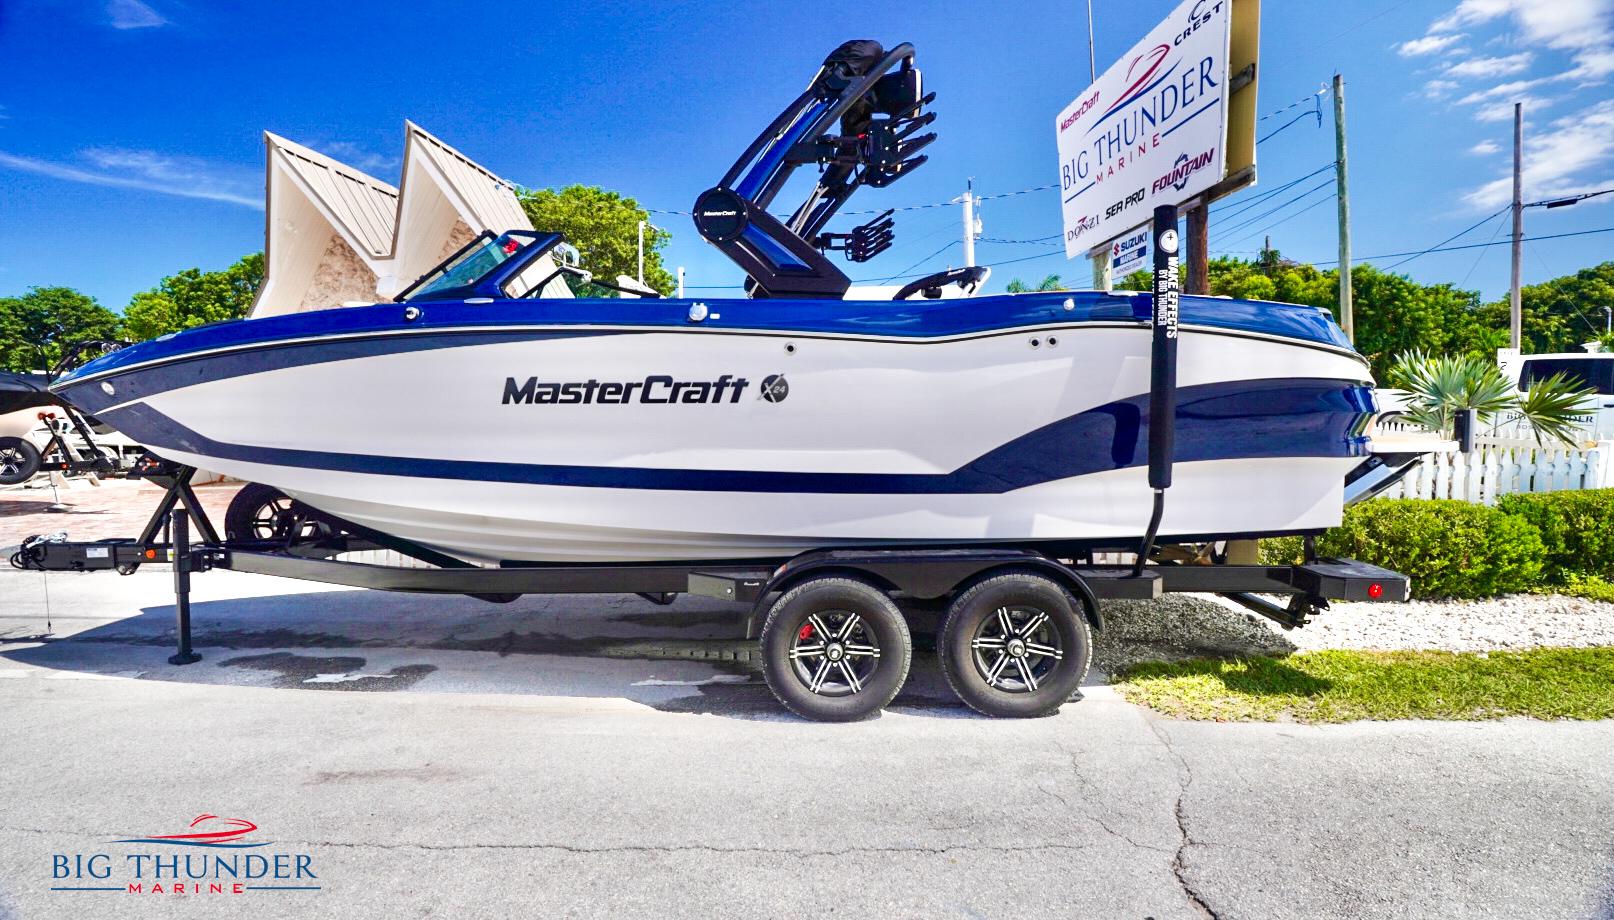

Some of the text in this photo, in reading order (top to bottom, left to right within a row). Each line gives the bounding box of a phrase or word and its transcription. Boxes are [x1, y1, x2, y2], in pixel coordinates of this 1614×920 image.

[1174, 1, 1223, 46] CREST
[1060, 91, 1100, 133] MasterCraft
[1062, 56, 1218, 191] BIG THUNDER
[1096, 133, 1160, 185] MARINE
[1152, 148, 1214, 195] FOUNTAIN
[1105, 188, 1145, 220] SEA PRO
[1067, 214, 1100, 241] DONZI
[1120, 231, 1147, 252] SUZUKI
[1157, 269, 1168, 326] BY BIG THUNDER
[1166, 256, 1179, 339] WAKE EFFECTS
[501, 374, 750, 405] MasterCraft
